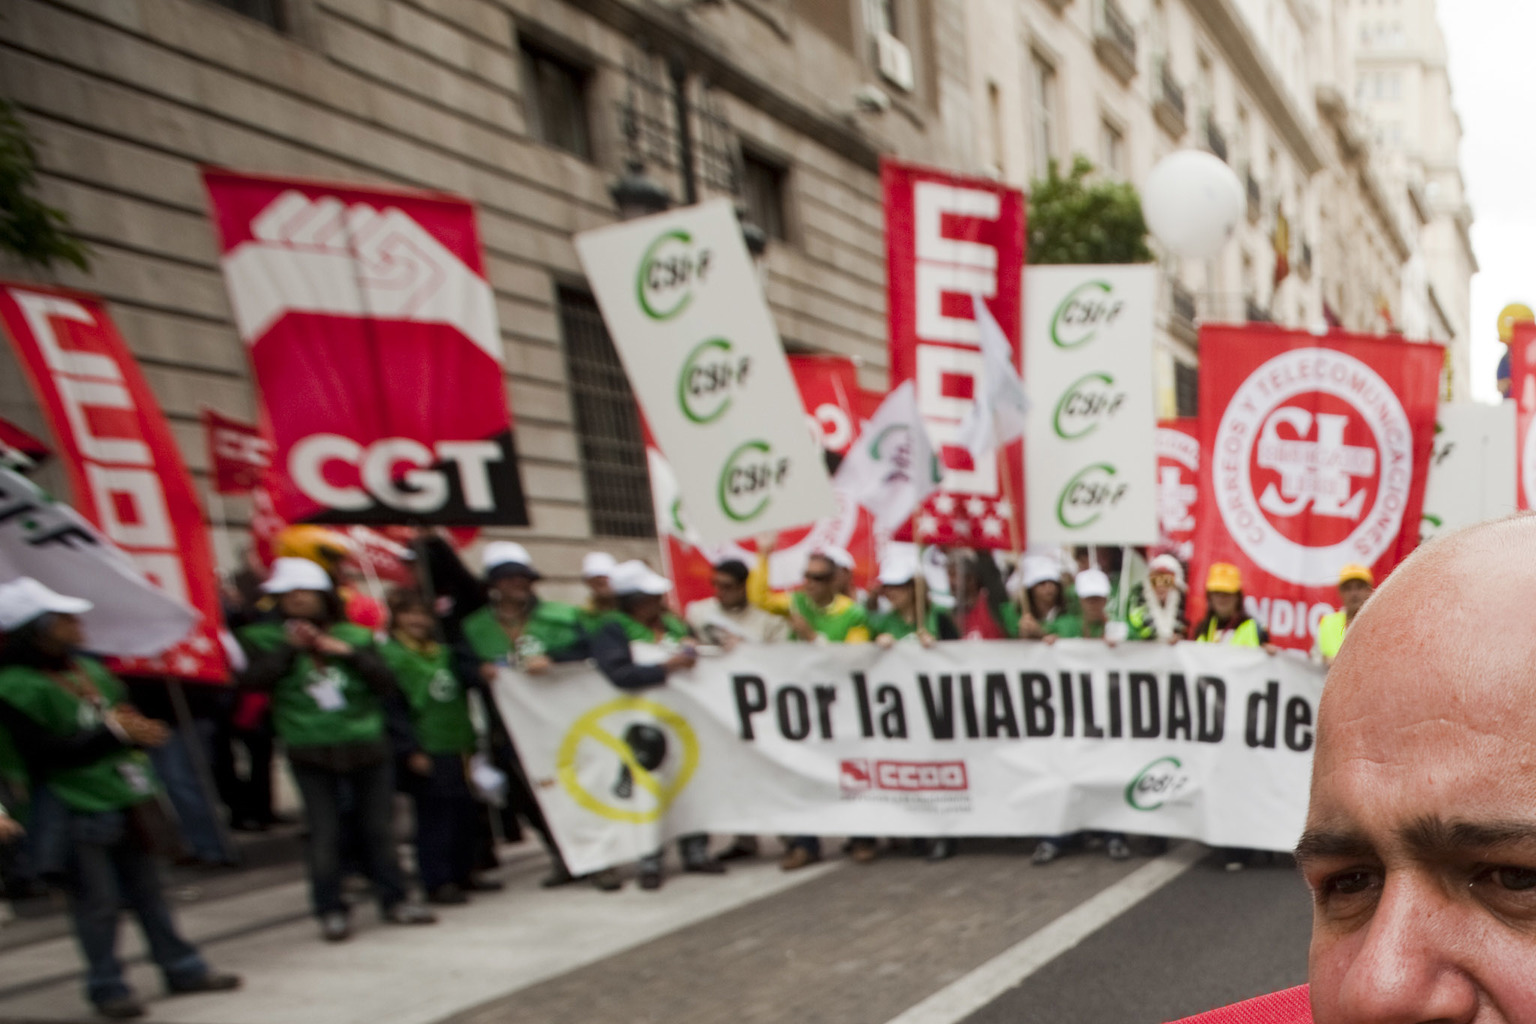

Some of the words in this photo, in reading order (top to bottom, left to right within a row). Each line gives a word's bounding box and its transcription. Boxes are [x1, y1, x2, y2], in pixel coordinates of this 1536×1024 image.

[287, 433, 504, 514] CGT
[730, 674, 838, 742] Por
[851, 671, 909, 740] la
[917, 671, 1228, 744] VIABILIDAD
[1246, 681, 1314, 752] de
